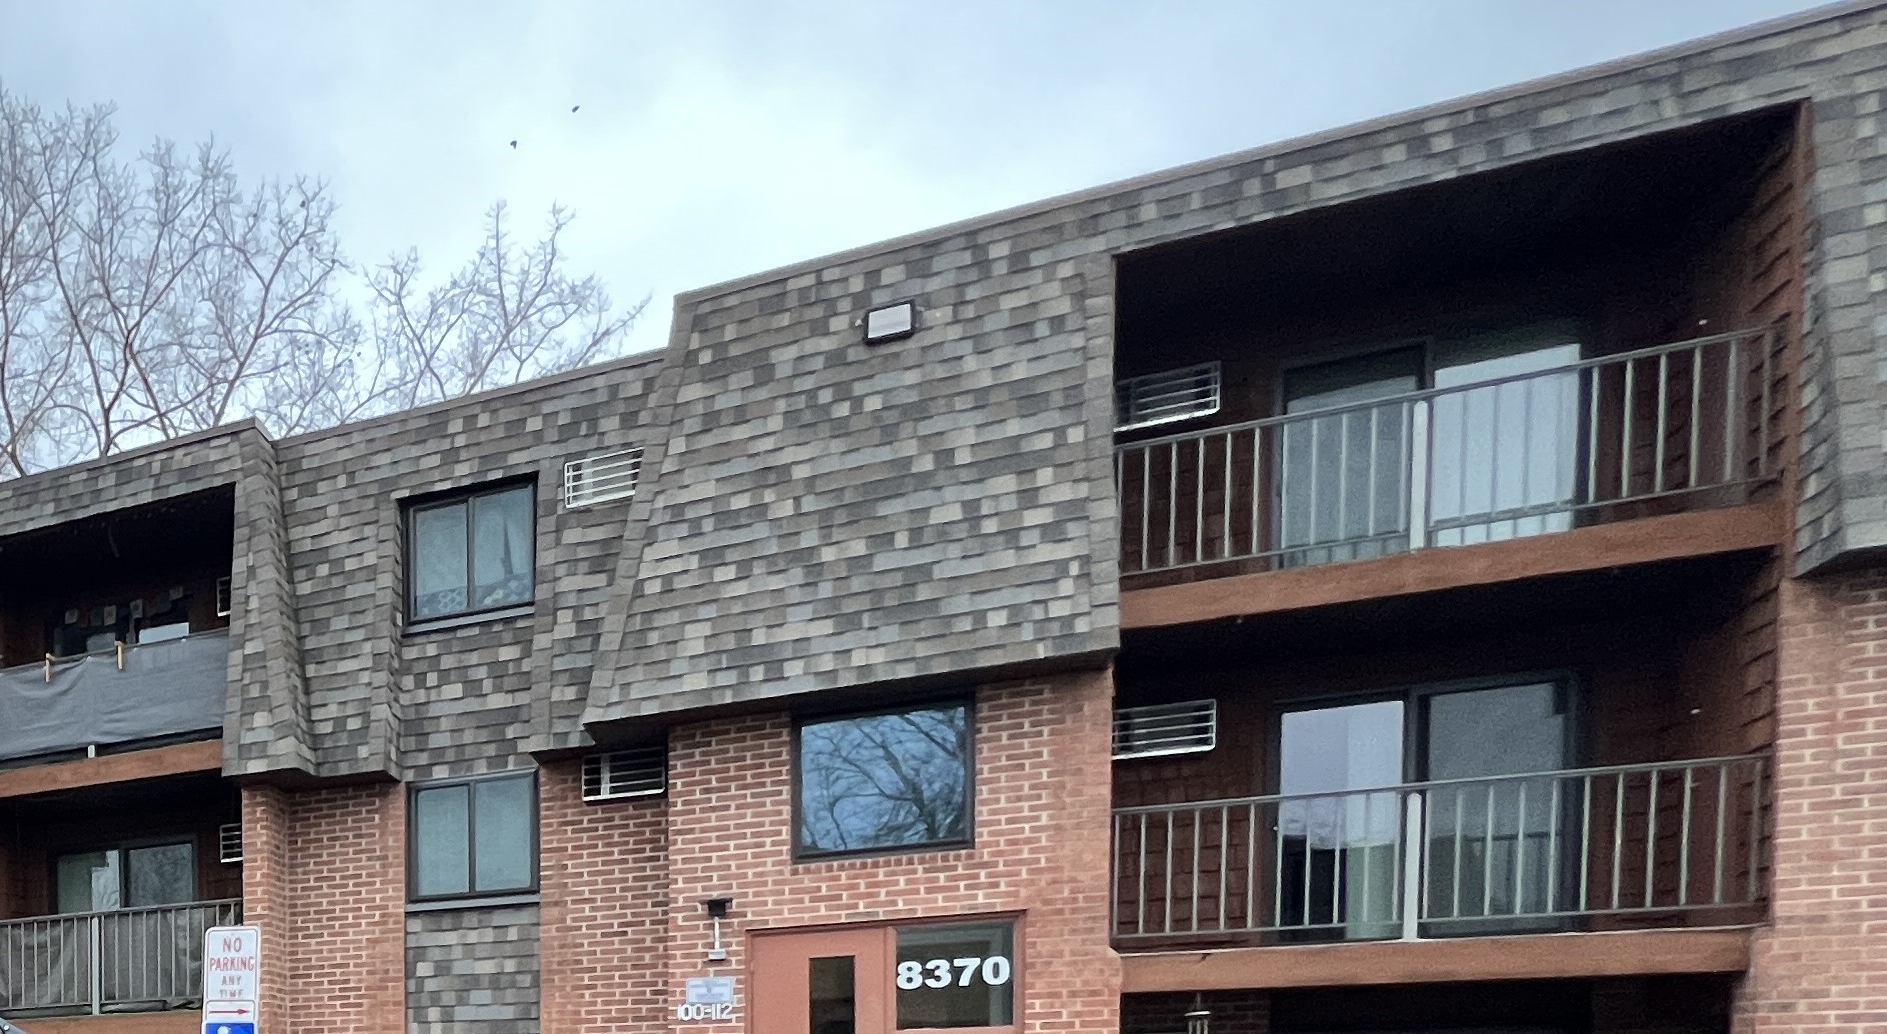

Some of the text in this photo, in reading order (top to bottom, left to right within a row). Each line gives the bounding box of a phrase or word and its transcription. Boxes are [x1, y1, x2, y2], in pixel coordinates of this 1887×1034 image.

[223, 938, 242, 953] NO
[209, 956, 254, 972] PARKING
[221, 975, 242, 986] ANY
[896, 956, 1010, 990] 8370
[677, 1003, 733, 1021] 100-112
